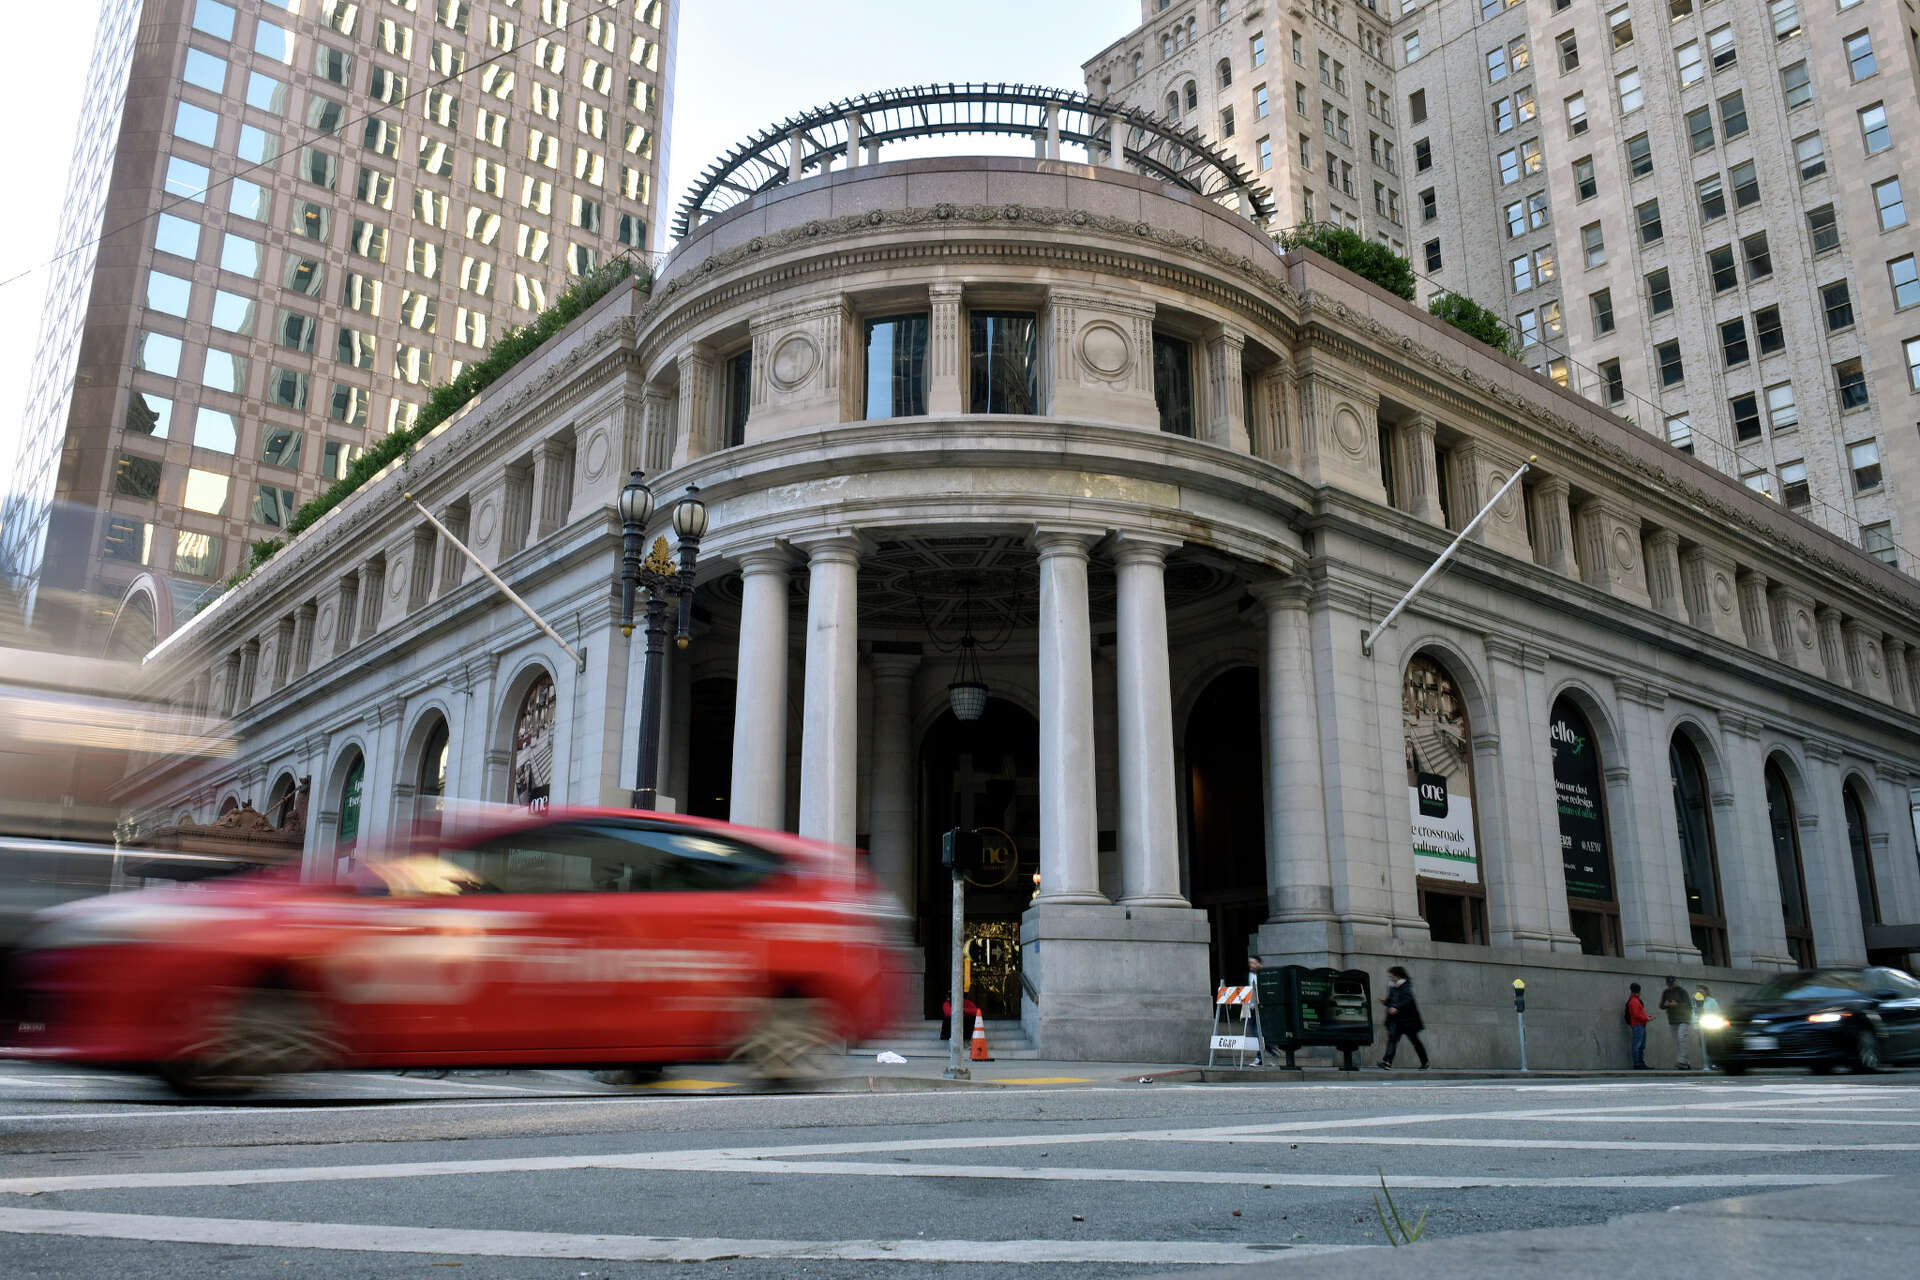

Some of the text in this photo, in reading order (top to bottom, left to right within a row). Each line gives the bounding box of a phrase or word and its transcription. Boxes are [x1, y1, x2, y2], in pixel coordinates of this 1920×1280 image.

[1551, 720, 1575, 744] ello
[1421, 784, 1444, 801] one
[1418, 826, 1465, 842] crossroads
[1413, 840, 1443, 855] culture
[1452, 848, 1471, 860] cool
